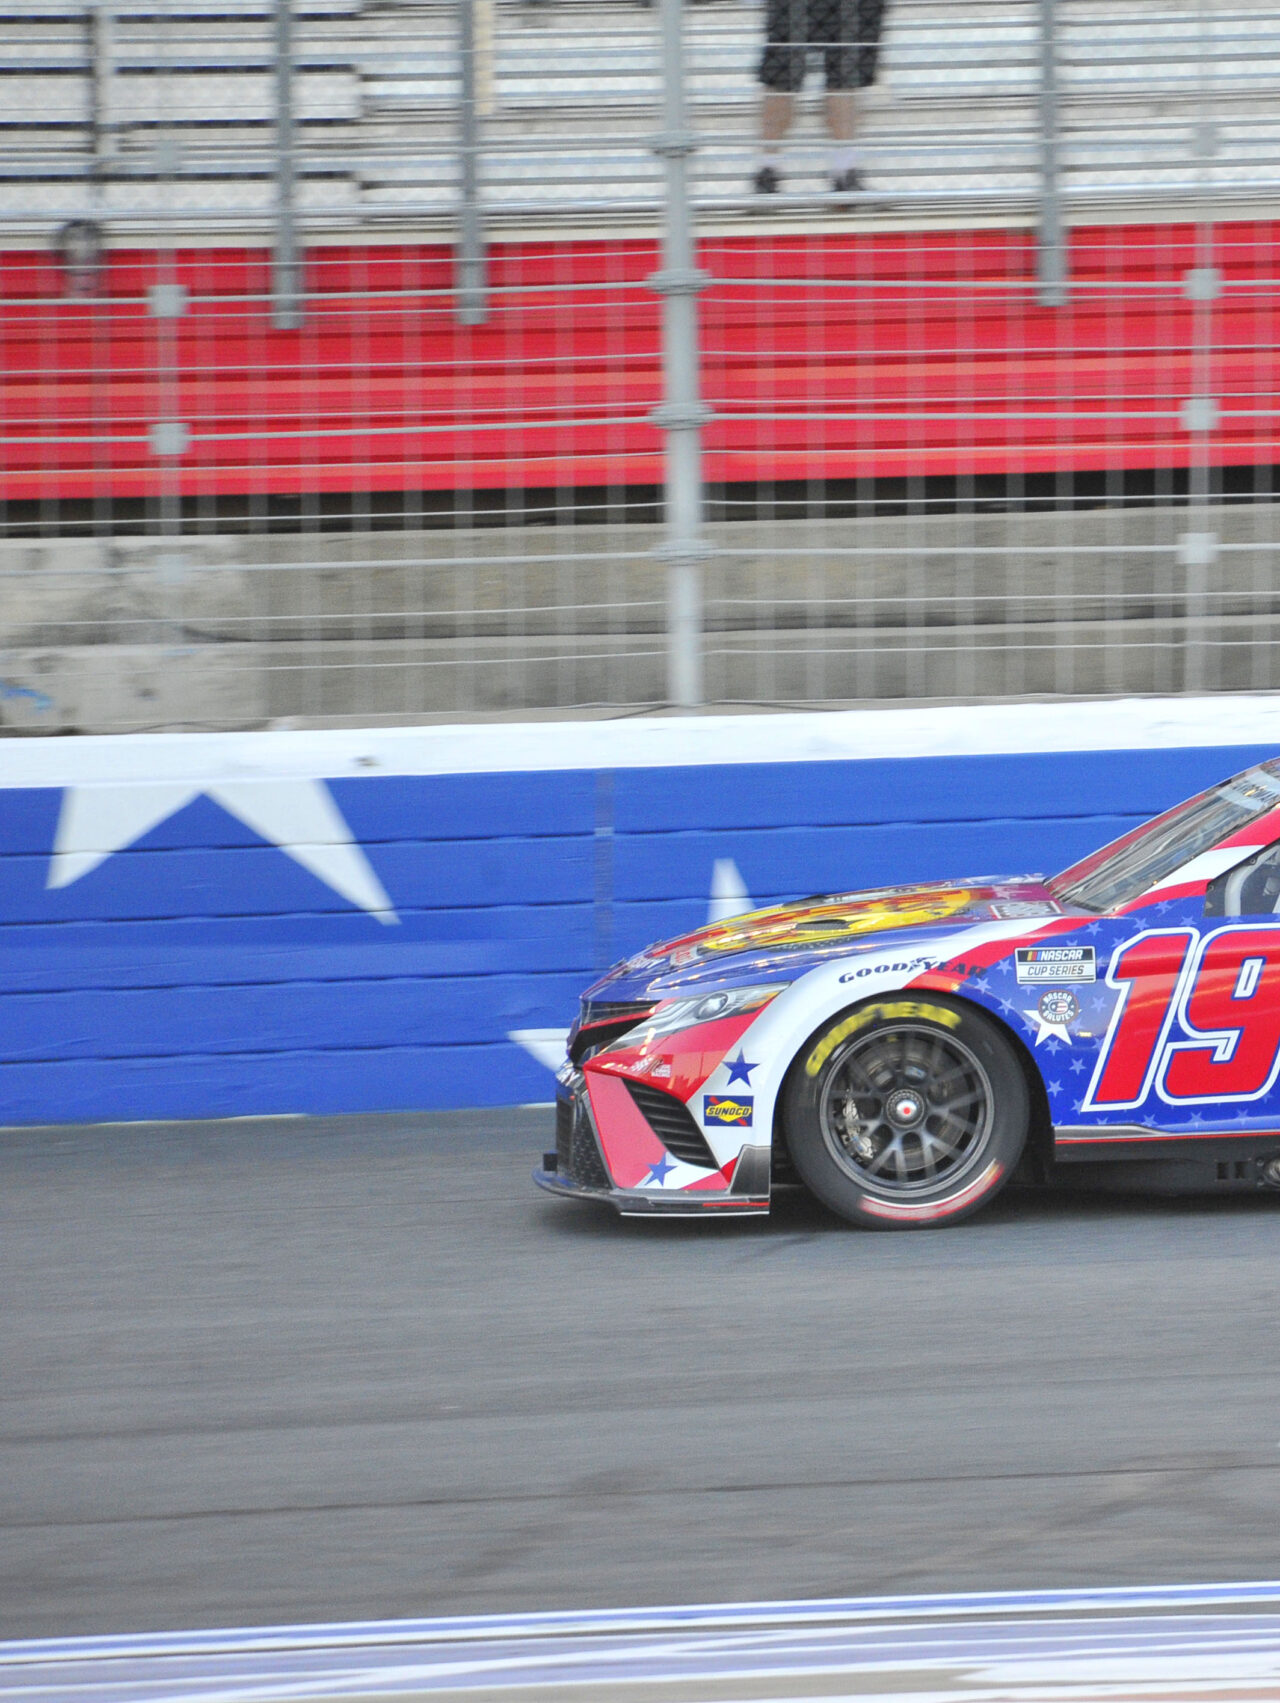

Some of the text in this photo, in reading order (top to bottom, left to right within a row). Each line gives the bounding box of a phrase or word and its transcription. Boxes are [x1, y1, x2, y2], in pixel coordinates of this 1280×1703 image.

[1040, 949, 1084, 961] NASCAR
[838, 956, 988, 984] GOODYEAR
[1027, 964, 1085, 976] CUP SERIES
[1042, 992, 1073, 1004] NASCAR
[1042, 1009, 1074, 1022] SALUTES
[707, 1107, 750, 1116] SUNOCO
